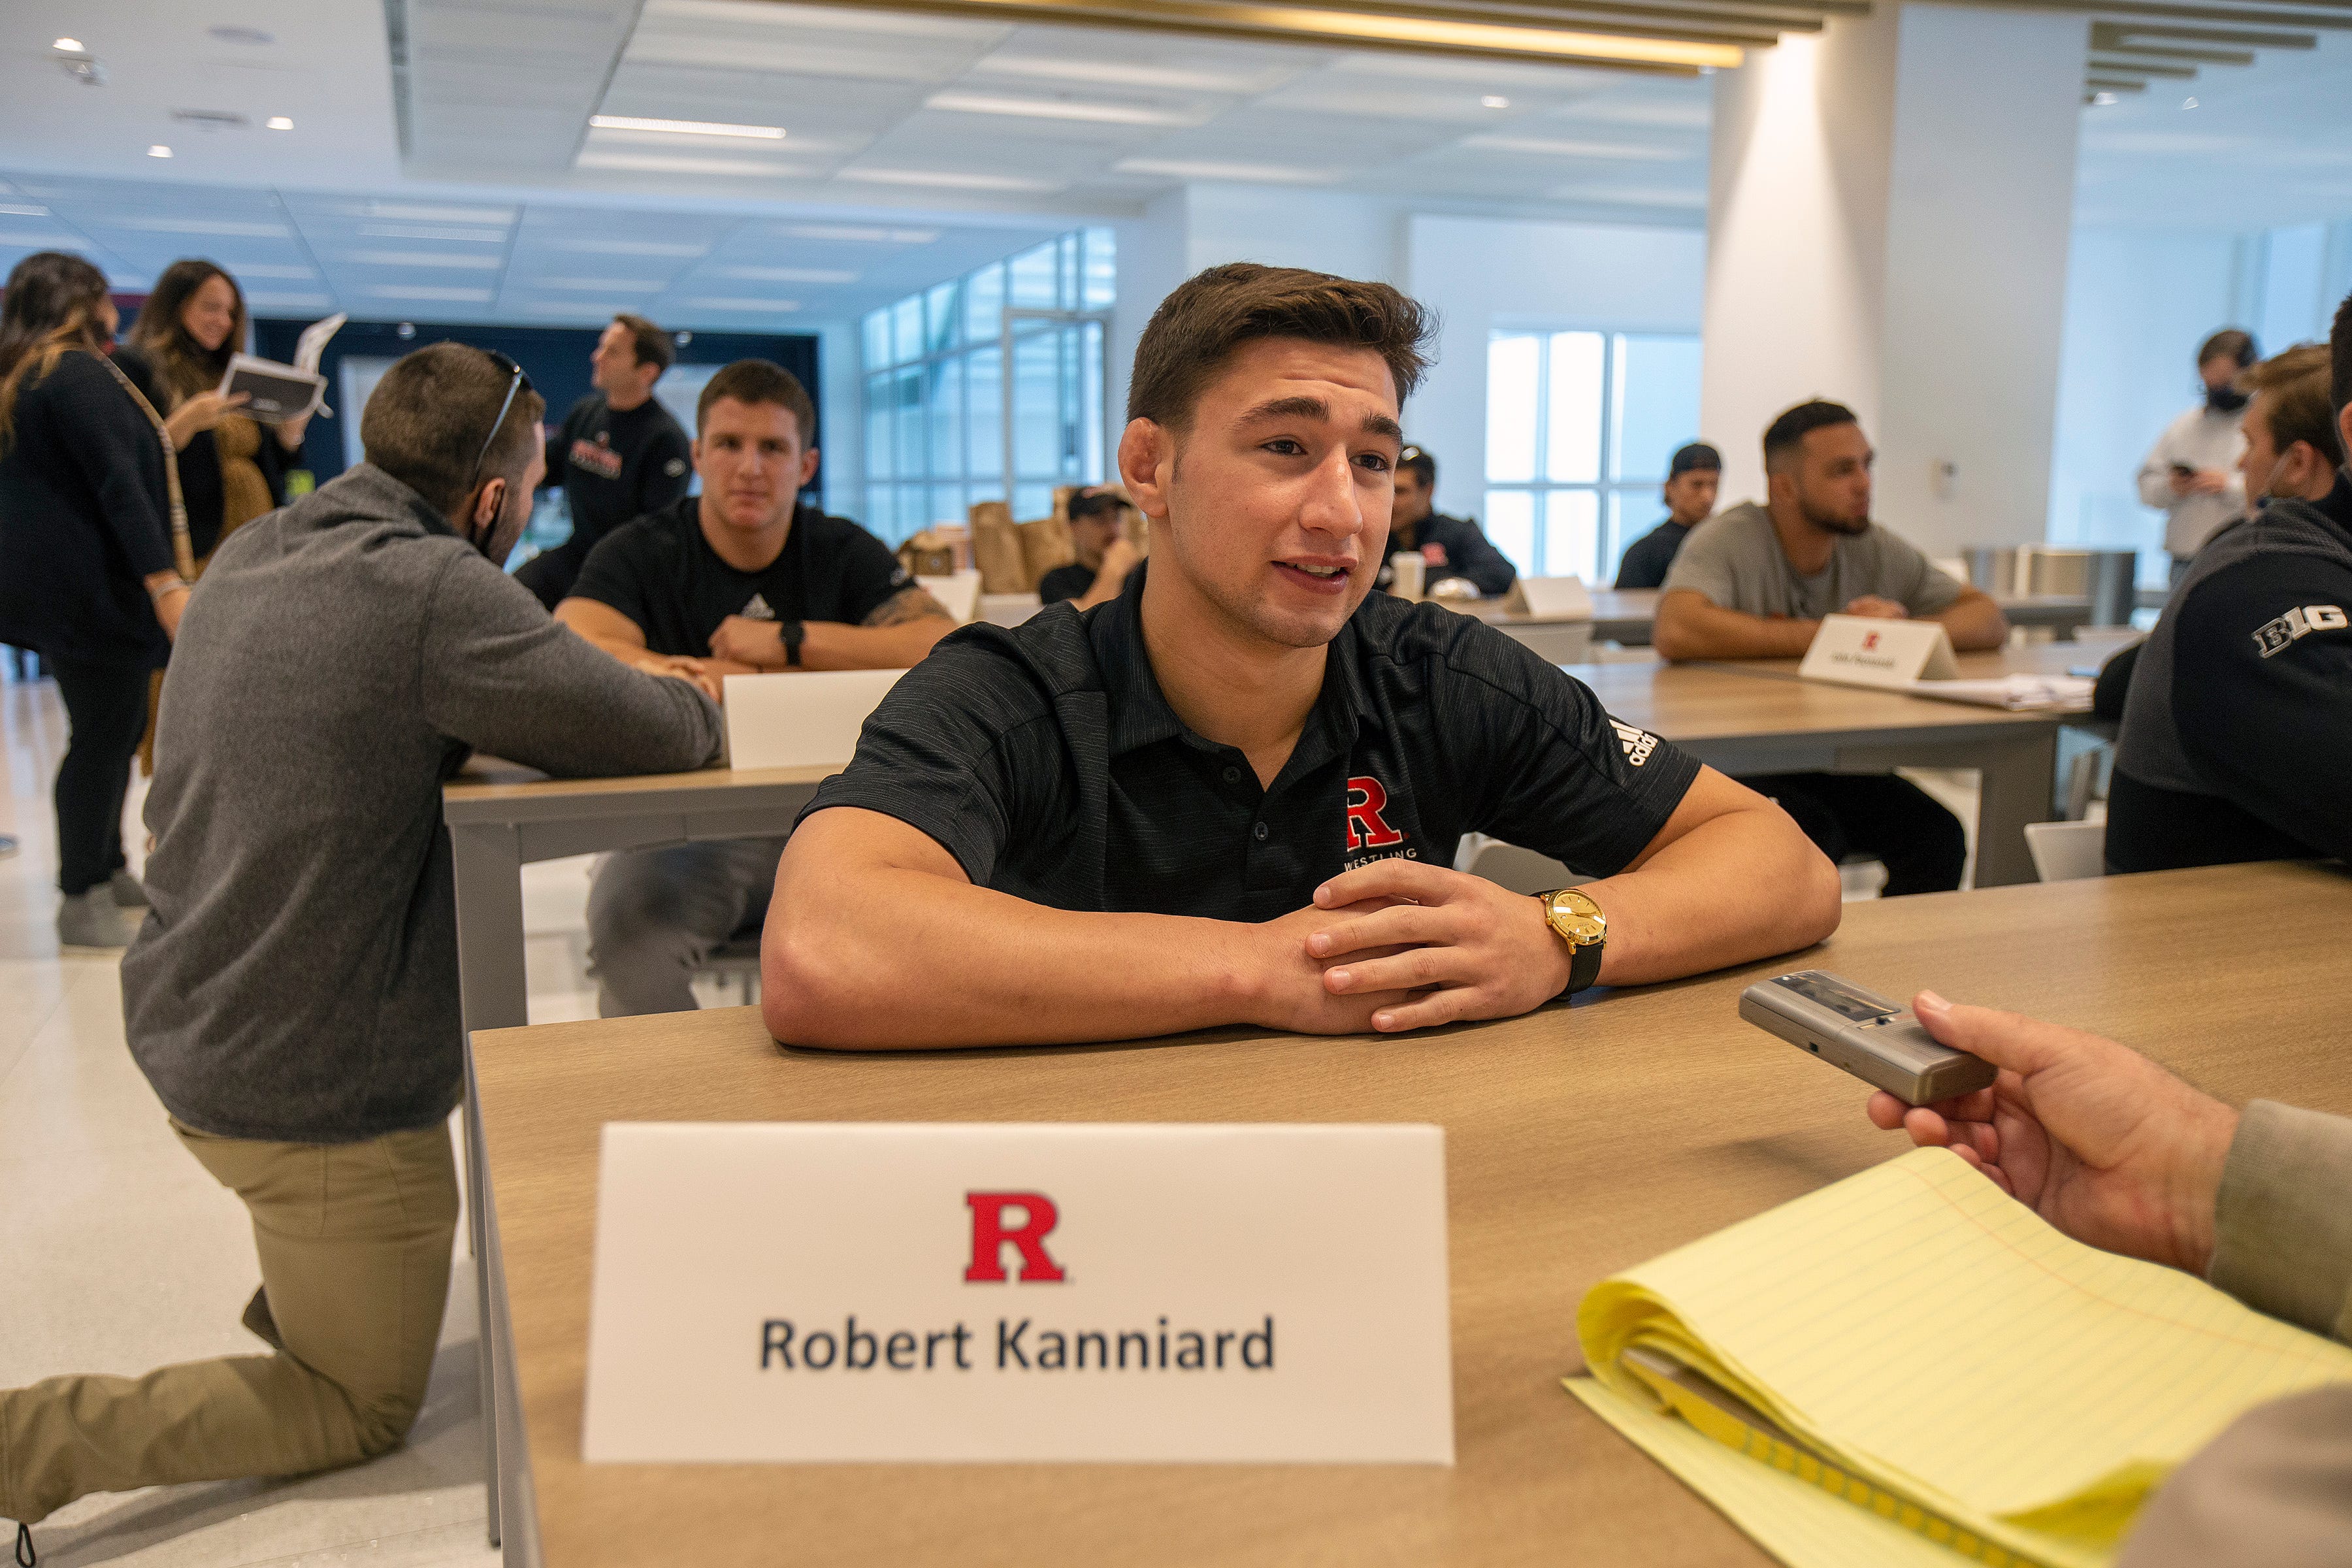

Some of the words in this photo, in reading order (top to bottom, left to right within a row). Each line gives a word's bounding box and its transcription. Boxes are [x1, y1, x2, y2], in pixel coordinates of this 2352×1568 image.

[1629, 732, 1658, 767] adid
[964, 1191, 1066, 1284] R
[760, 1316, 972, 1371] Robert
[996, 1316, 1275, 1371] Kanniard
